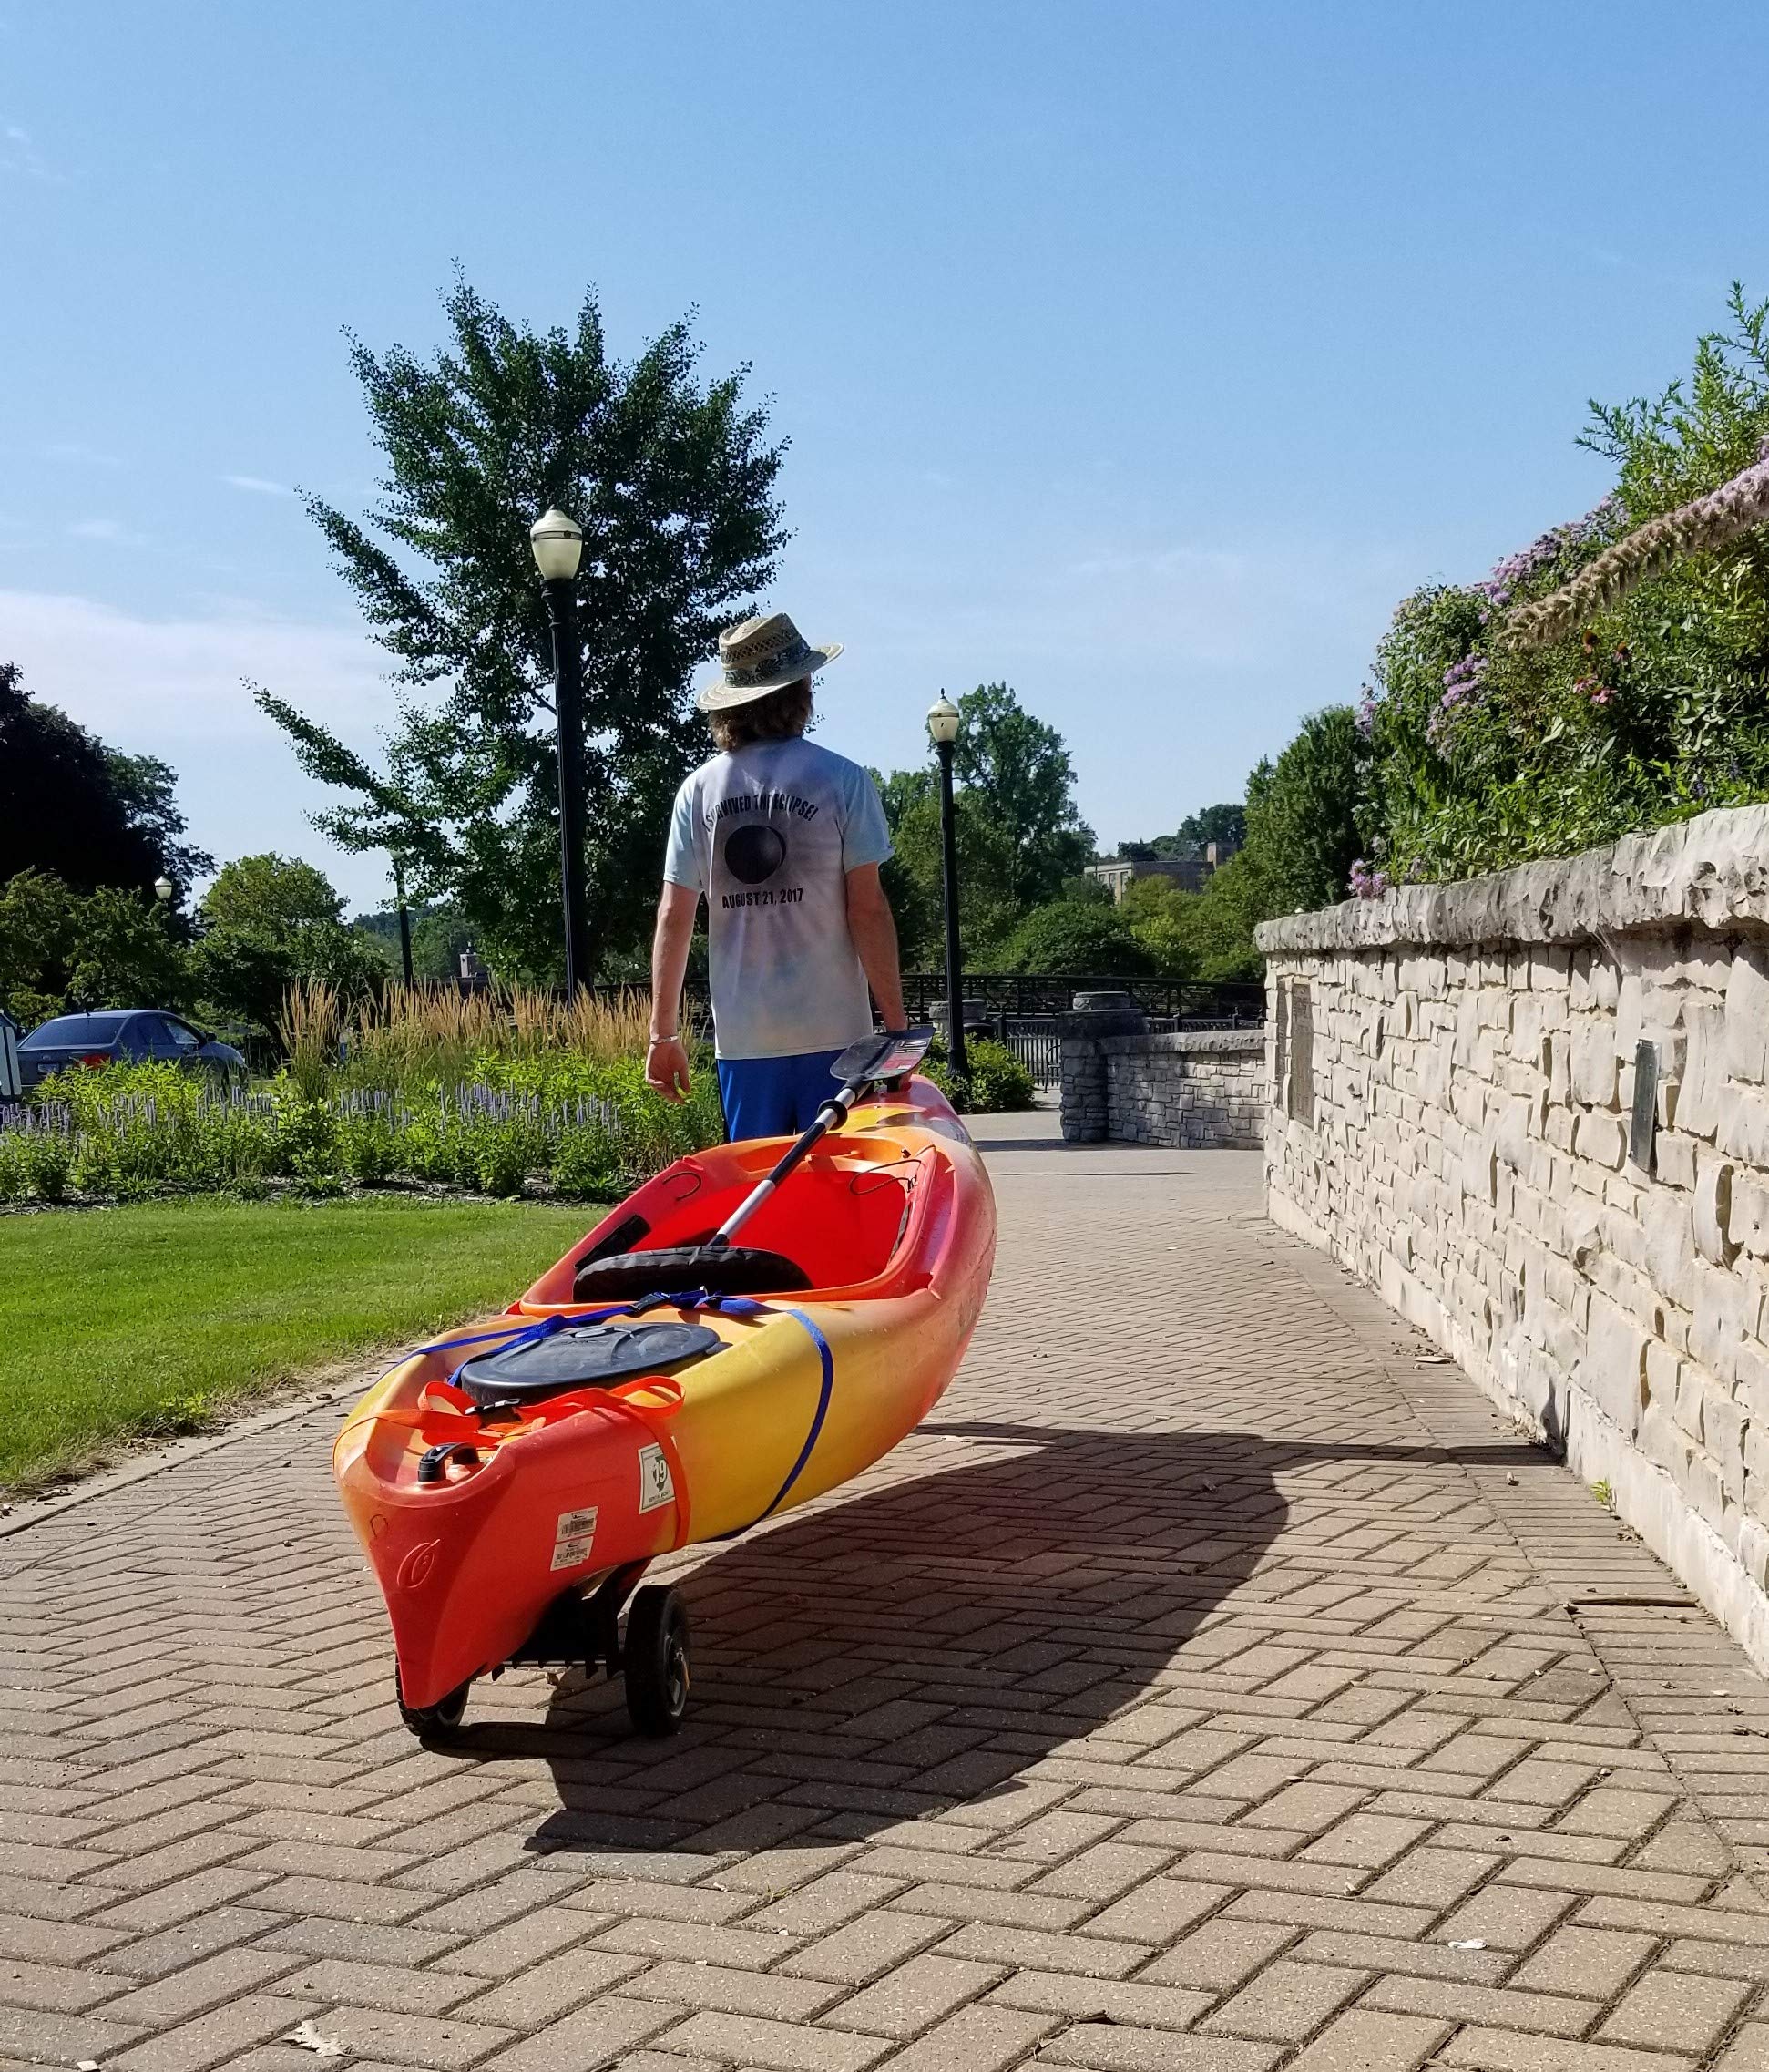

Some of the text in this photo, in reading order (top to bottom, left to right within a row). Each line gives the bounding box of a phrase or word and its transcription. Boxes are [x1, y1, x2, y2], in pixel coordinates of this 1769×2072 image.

[706, 795, 752, 825] SURVIVED
[722, 887, 803, 908] AUGUST 21, 2017
[654, 1460, 667, 1483] 19
